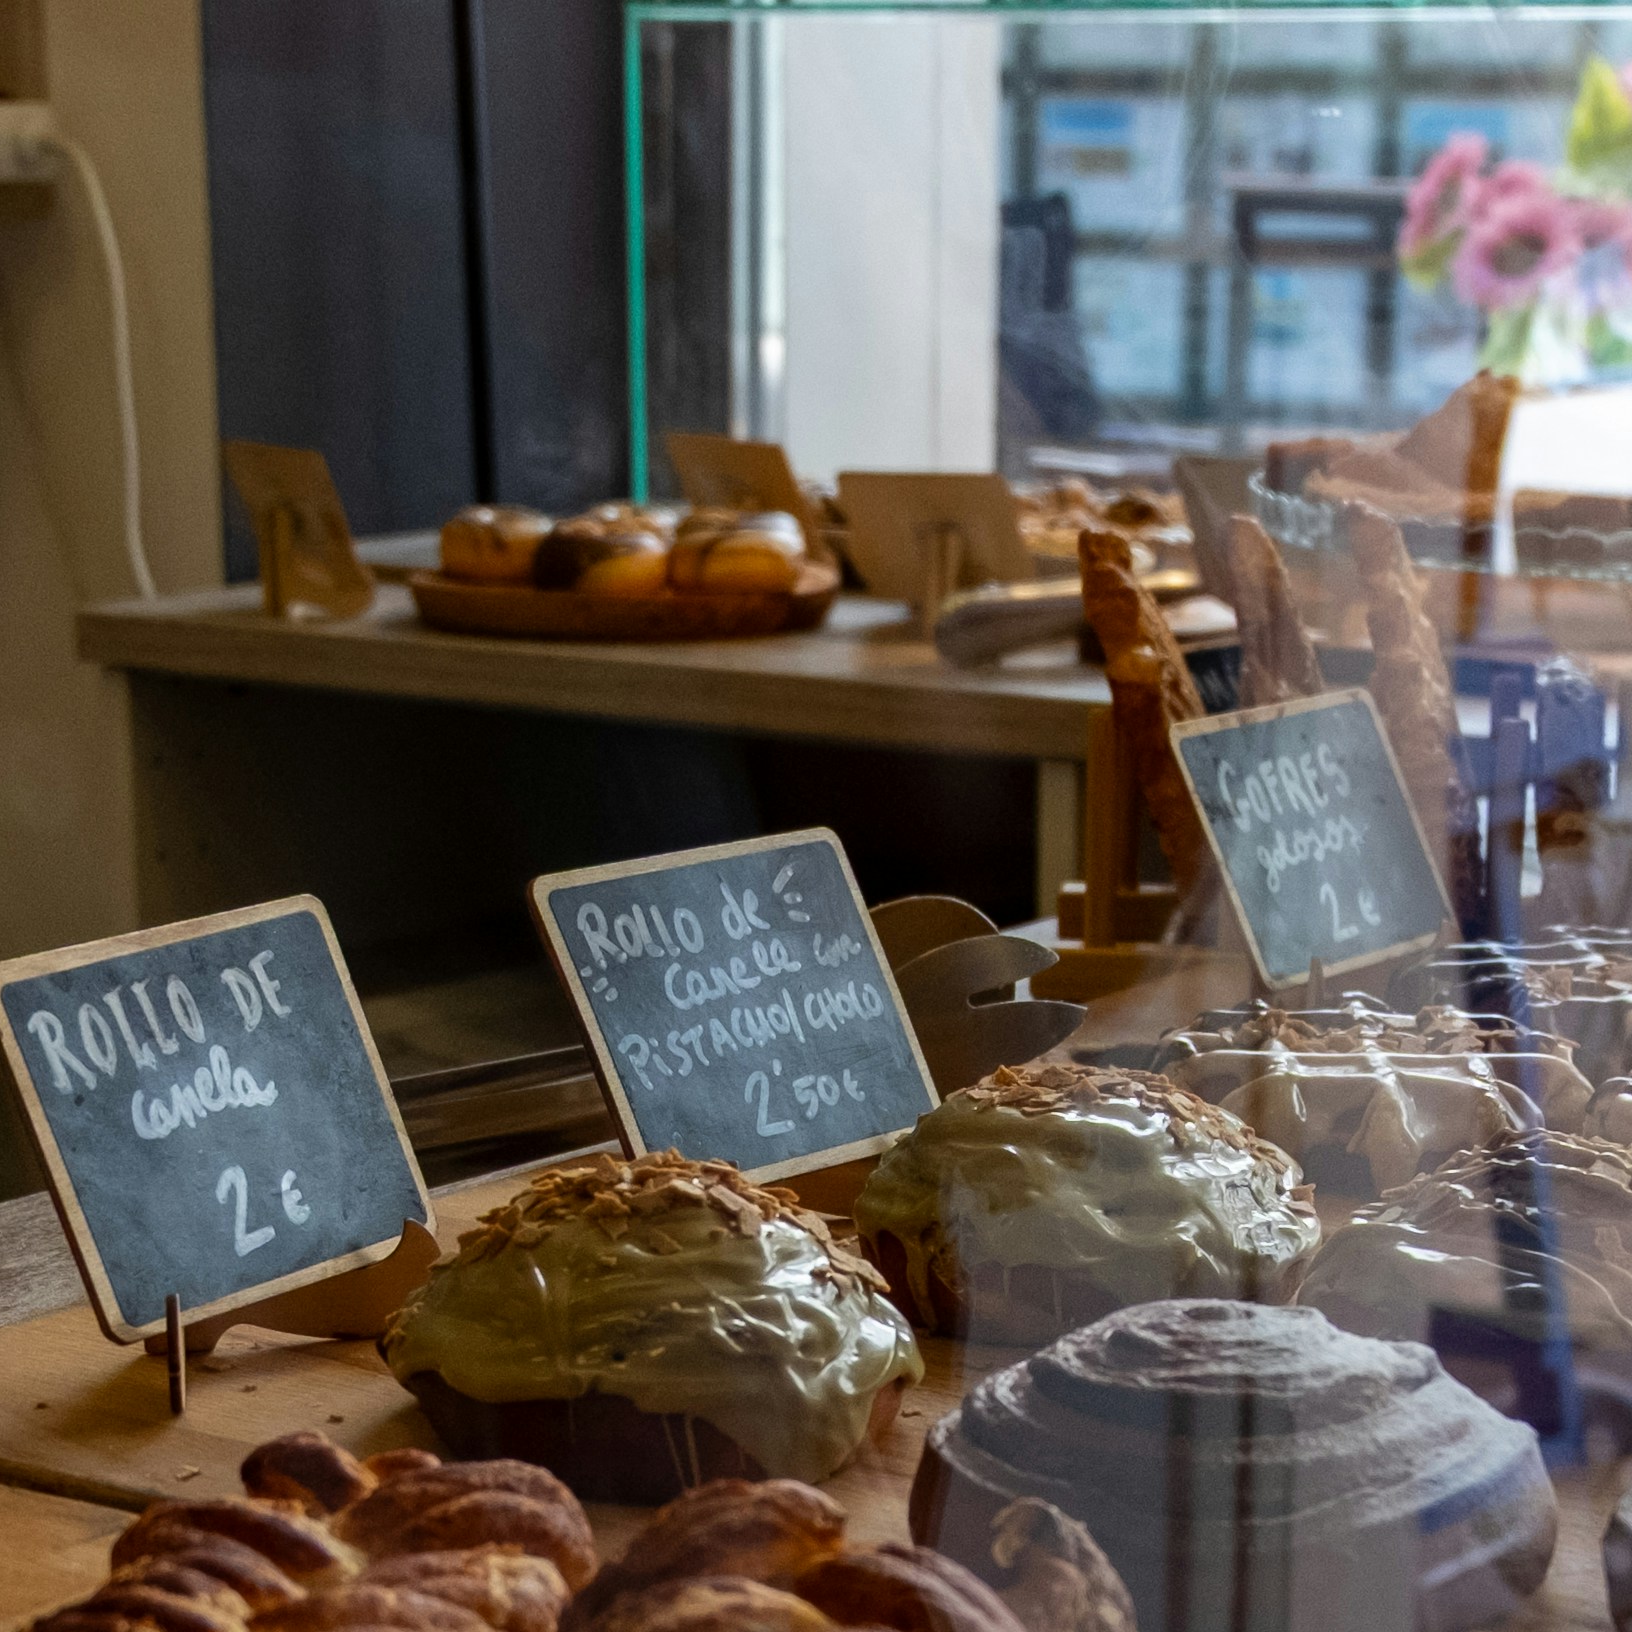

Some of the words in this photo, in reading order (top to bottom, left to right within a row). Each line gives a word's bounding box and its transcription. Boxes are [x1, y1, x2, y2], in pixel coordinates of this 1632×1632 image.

[1218, 743, 1351, 833] GOFRES
[717, 880, 771, 941] de
[27, 974, 207, 1096] ROLLO
[220, 949, 292, 1033] DE
